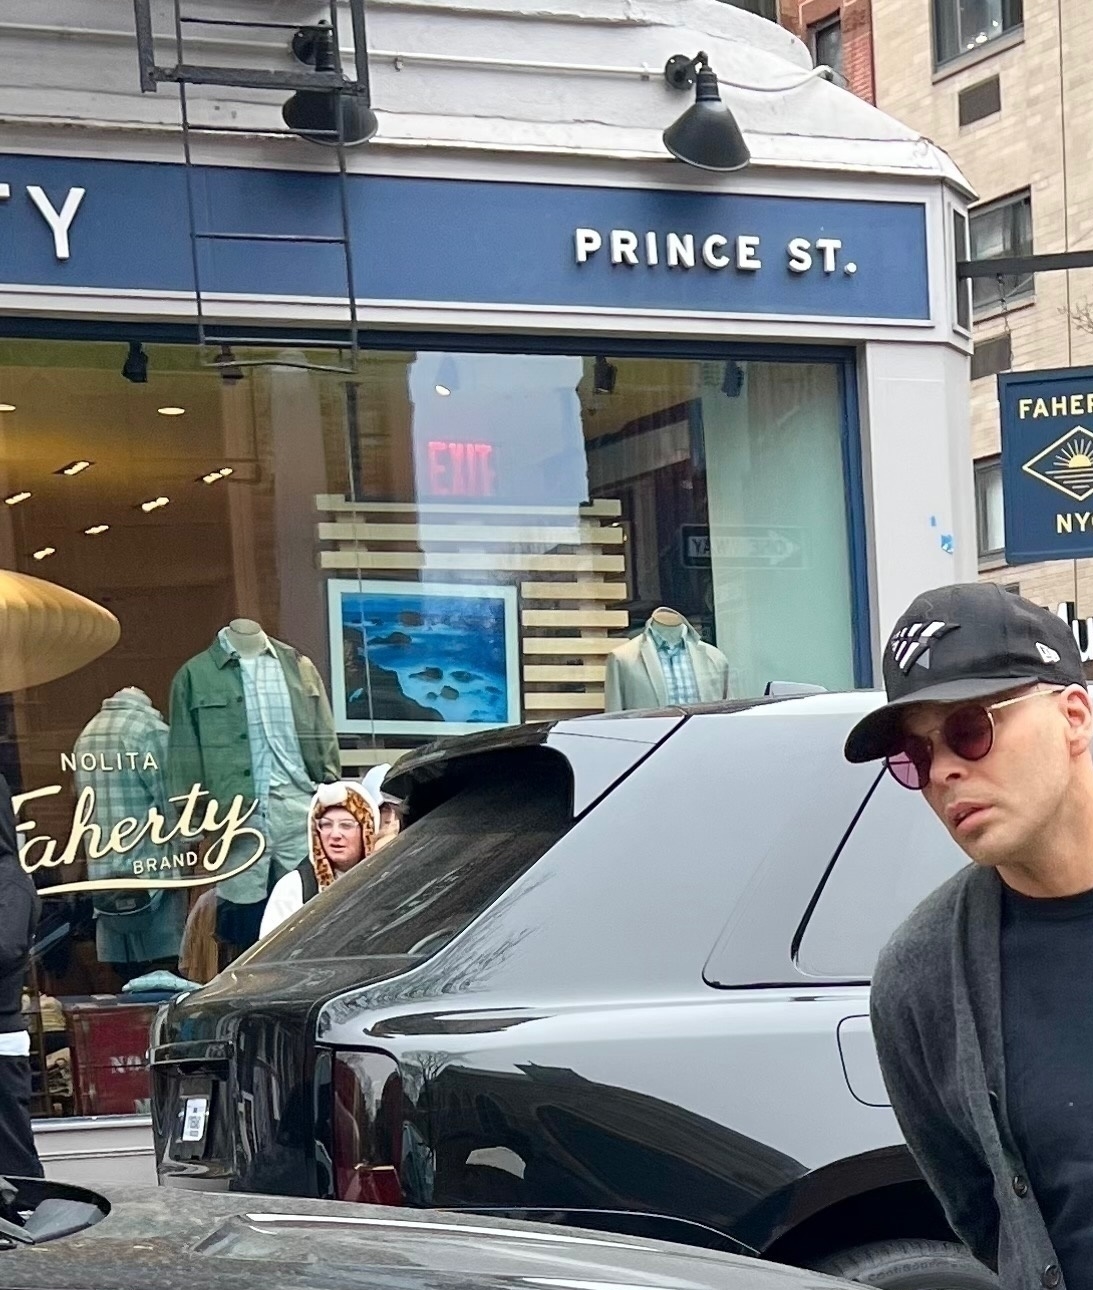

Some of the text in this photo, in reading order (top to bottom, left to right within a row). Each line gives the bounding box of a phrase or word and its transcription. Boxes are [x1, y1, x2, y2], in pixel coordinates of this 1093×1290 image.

[0, 183, 86, 259] Y
[575, 228, 857, 275] PRINCE ST.
[428, 441, 493, 496] EXIT
[61, 752, 158, 771] NOLITA
[133, 851, 198, 874] BRAND
